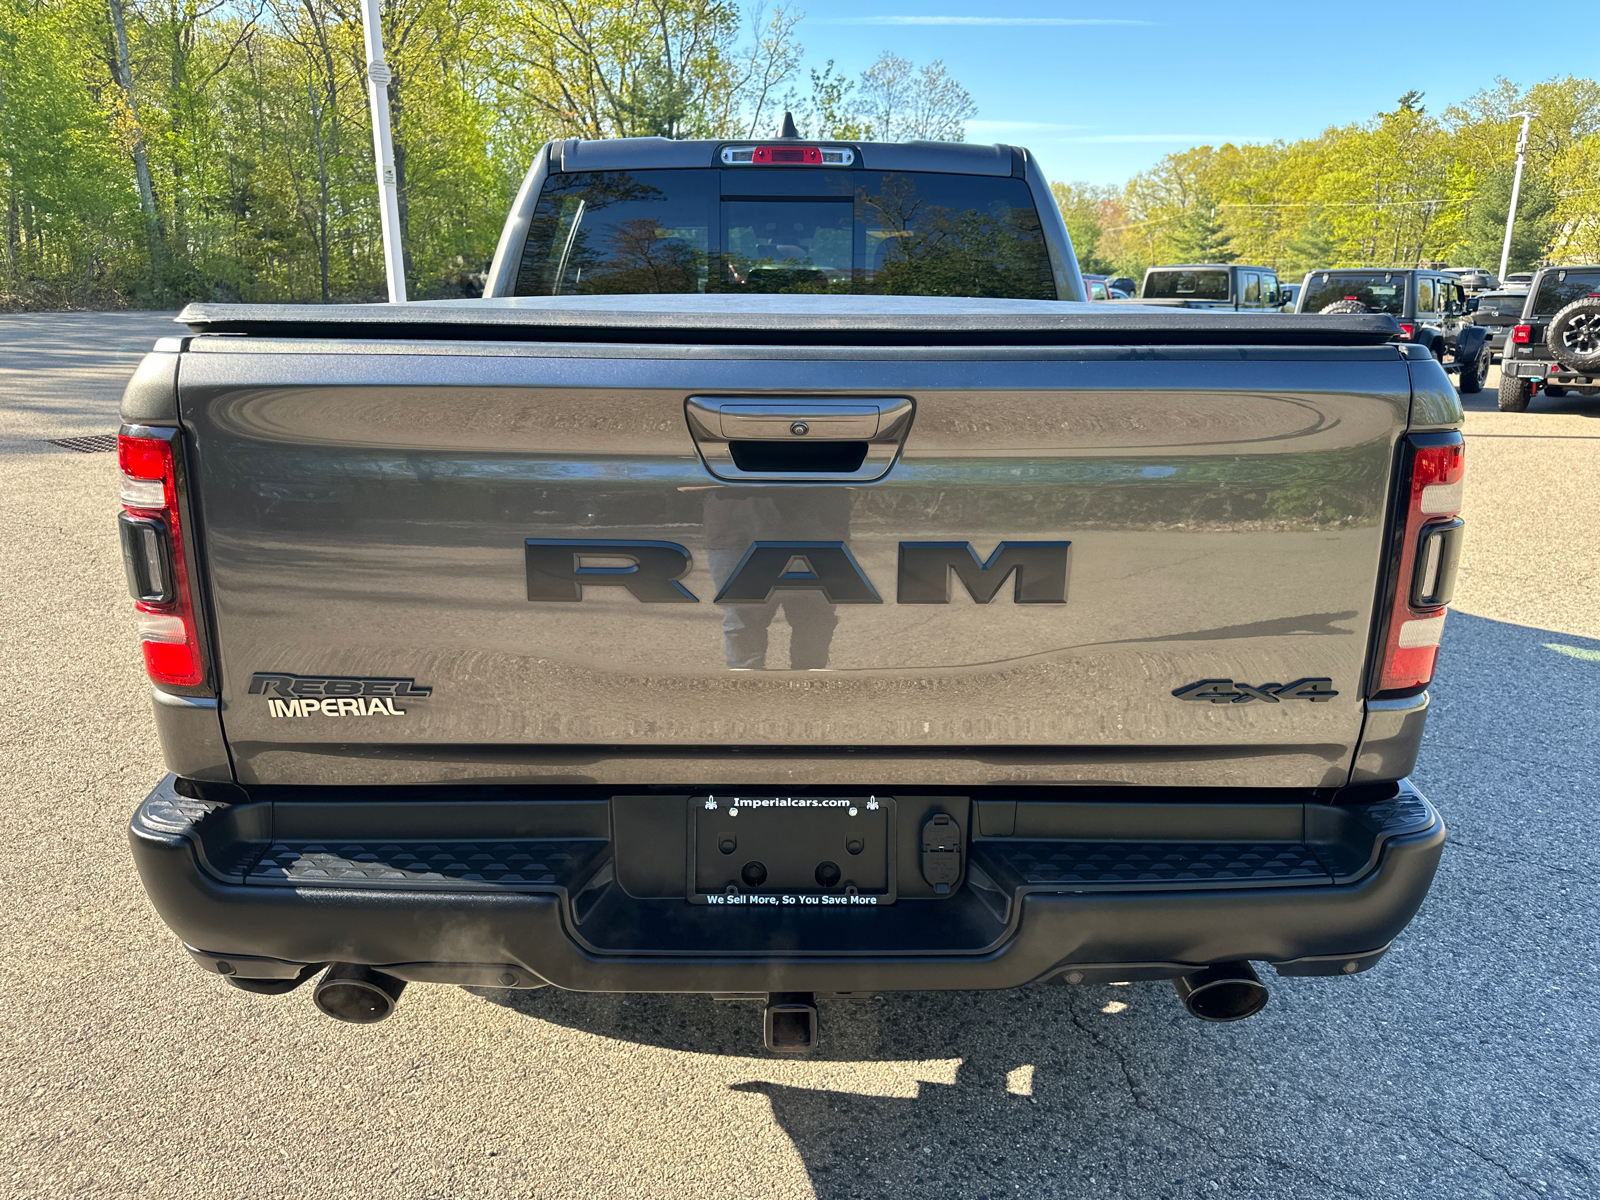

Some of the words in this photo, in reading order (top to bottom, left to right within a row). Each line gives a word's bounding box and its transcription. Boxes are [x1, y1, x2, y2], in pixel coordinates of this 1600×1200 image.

[524, 538, 1072, 604] RAM
[248, 671, 433, 697] REBEL
[267, 697, 407, 718] IMPERIAL
[733, 797, 851, 809] Imperialcars.com
[707, 895, 724, 904] We
[727, 895, 746, 904] Sell
[749, 895, 779, 906] More,
[782, 895, 796, 904] So
[799, 895, 819, 904] You
[821, 895, 848, 904] Save
[850, 895, 877, 904] More
